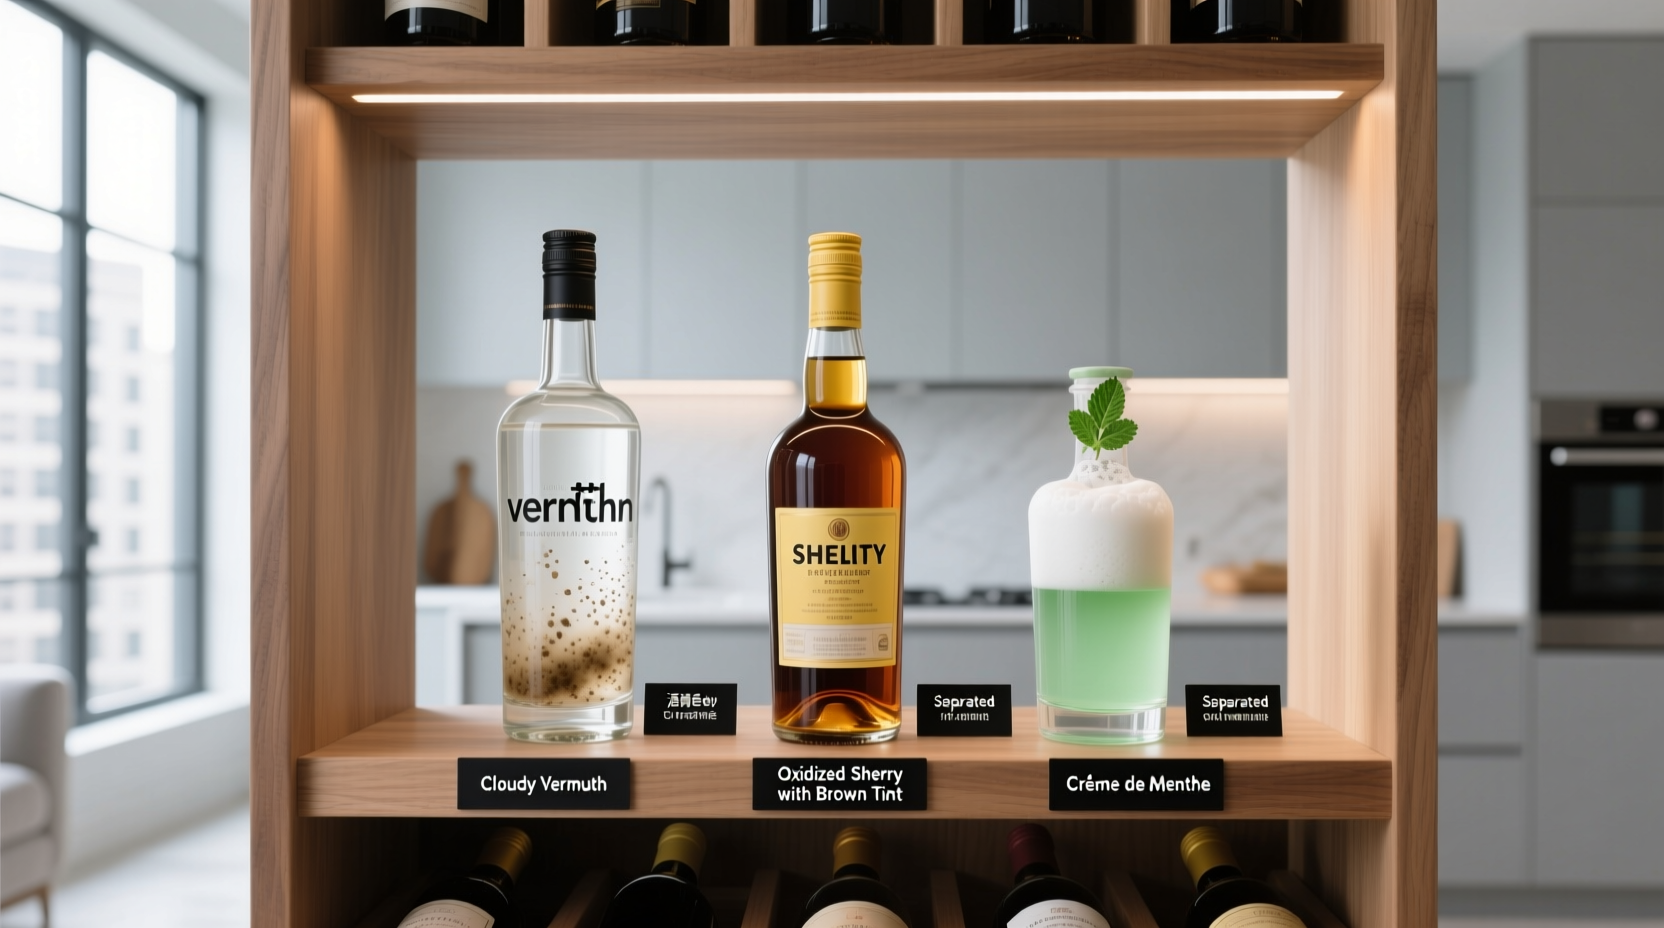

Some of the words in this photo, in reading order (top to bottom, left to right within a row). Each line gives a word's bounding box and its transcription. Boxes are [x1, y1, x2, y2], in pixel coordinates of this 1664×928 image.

[792, 543, 887, 565] SHELITY
[480, 774, 537, 796] Cloudy
[540, 775, 607, 793] Vermuth
[777, 765, 845, 782] Oxidized
[850, 765, 904, 785] Sherry
[1124, 774, 1146, 792] de
[1149, 774, 1211, 793] Menthe
[777, 785, 812, 802] with
[815, 785, 867, 802] Brown
[870, 784, 904, 802] Tint
